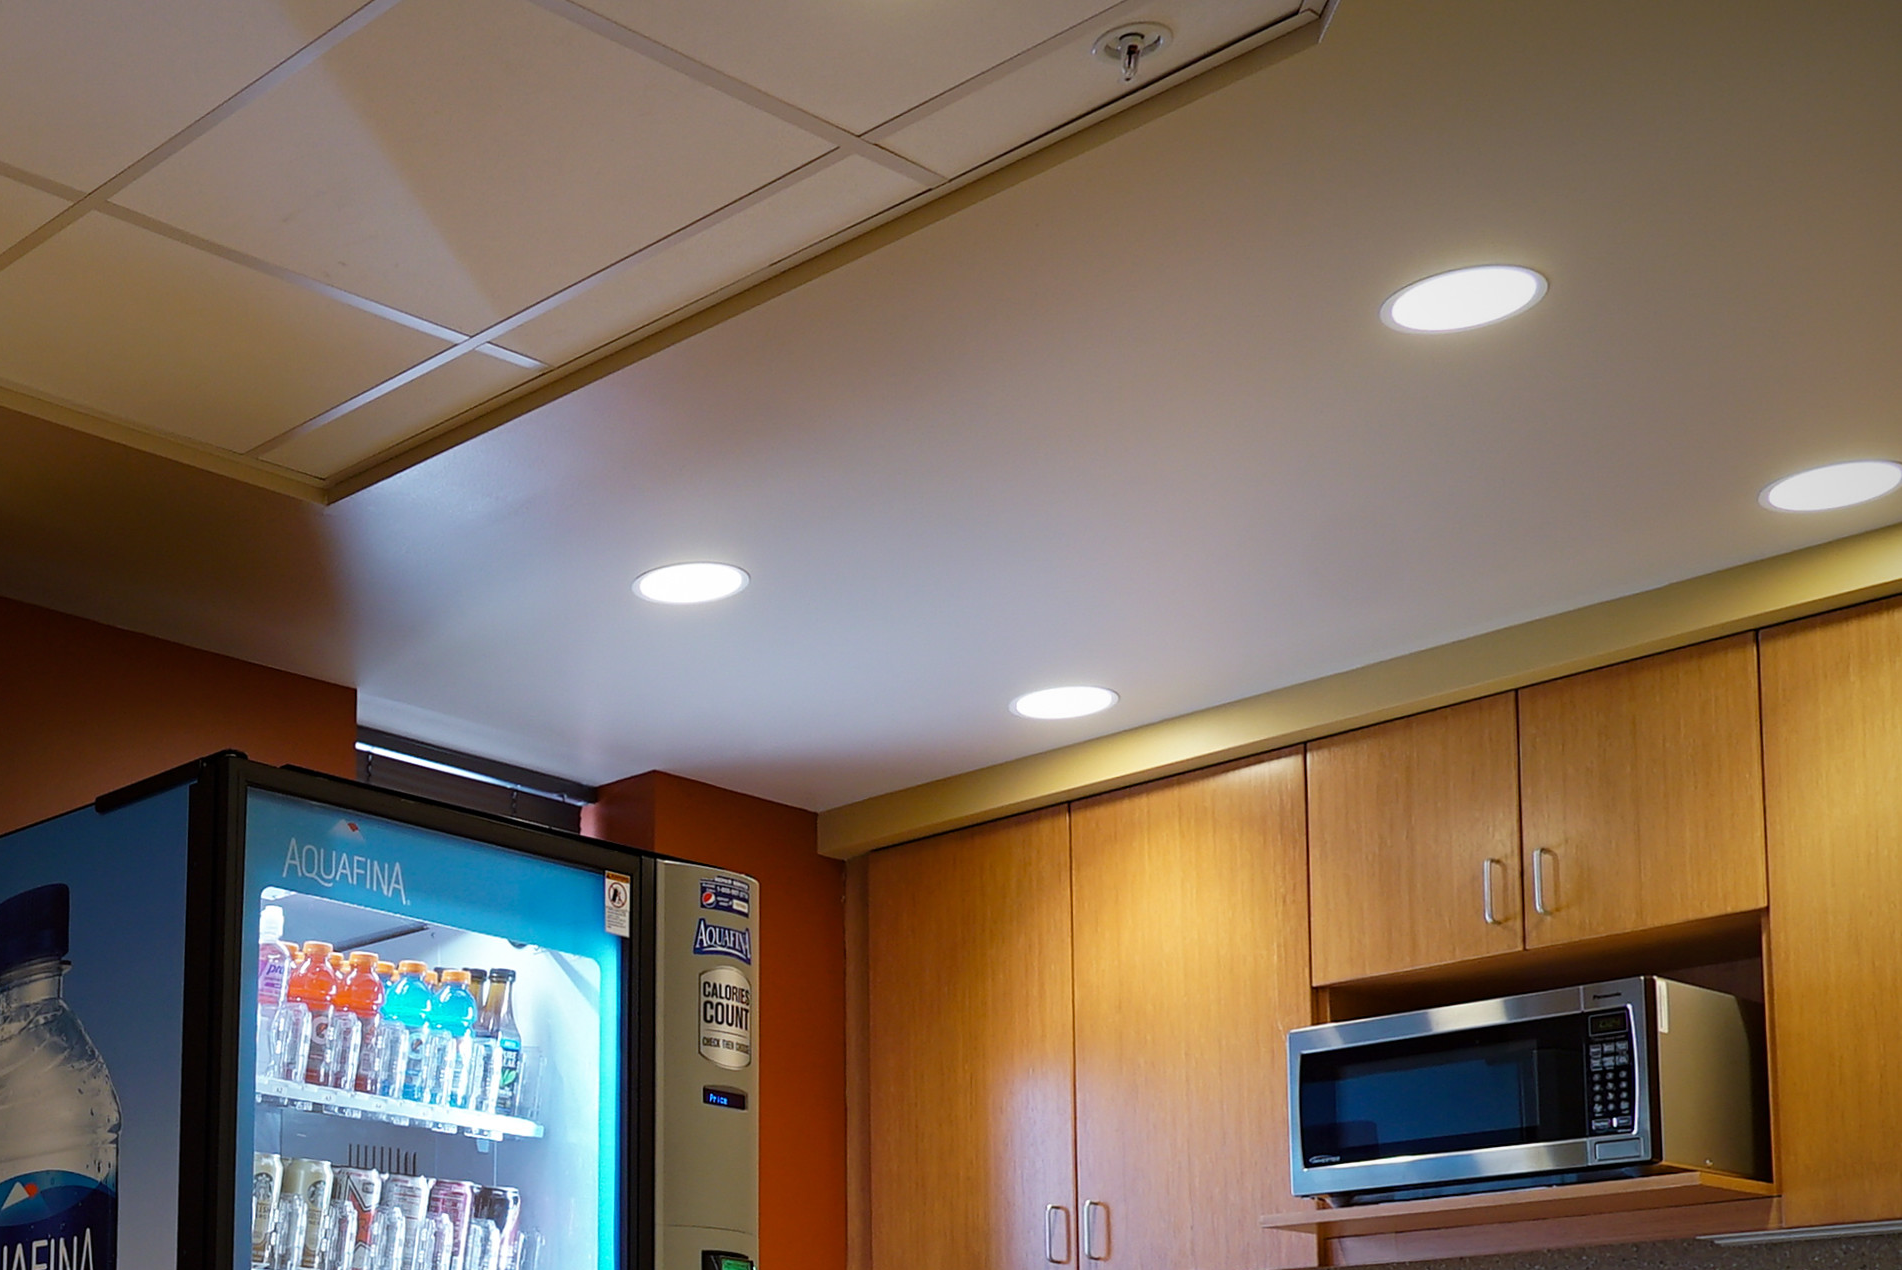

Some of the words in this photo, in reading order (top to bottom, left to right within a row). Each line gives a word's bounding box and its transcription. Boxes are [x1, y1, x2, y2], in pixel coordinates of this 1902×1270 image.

[282, 837, 407, 906] AQUAFINA
[695, 919, 751, 959] AQUAFINA
[702, 981, 750, 1006] CALORIES
[702, 1001, 749, 1031] COUNT
